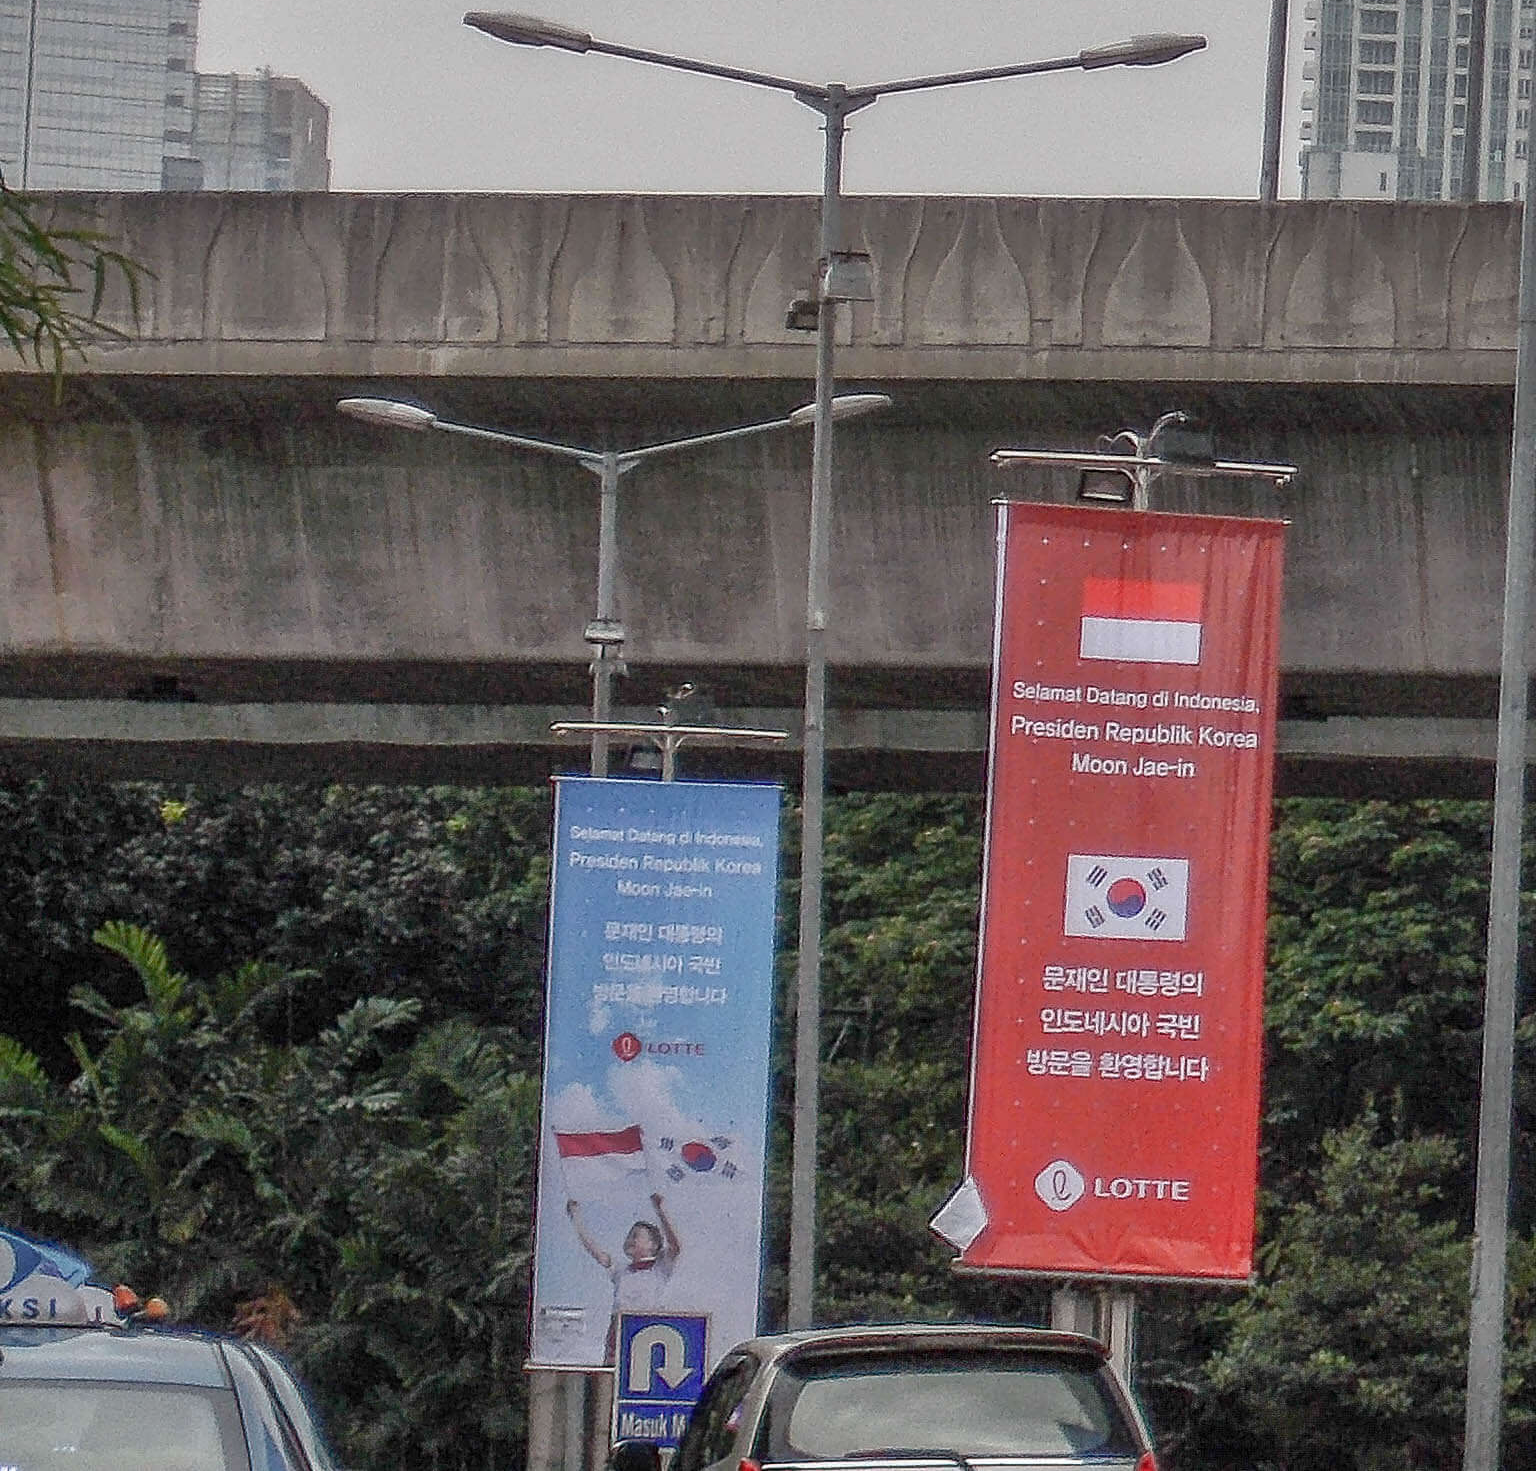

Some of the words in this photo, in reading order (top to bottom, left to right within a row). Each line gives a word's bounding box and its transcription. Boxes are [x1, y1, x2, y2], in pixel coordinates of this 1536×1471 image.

[1013, 681, 1082, 703] Selamat
[1086, 687, 1147, 710] Datang
[1152, 691, 1168, 707] di
[1011, 716, 1099, 740] Presiden
[1106, 721, 1193, 746] Republik
[1199, 726, 1258, 747] Korea
[1072, 754, 1128, 776] Moon
[1133, 757, 1195, 779] Jae-in
[1043, 966, 1108, 992] 문재인
[1115, 968, 1203, 995] 대통령의
[1040, 1008, 1150, 1036] 인도네시아
[1156, 1012, 1199, 1038] 국빈
[1026, 1049, 1092, 1075] 방문을
[1099, 1051, 1208, 1081] 환영합니다
[1093, 1177, 1190, 1202] LOTTE
[621, 1411, 667, 1438] Masuk
